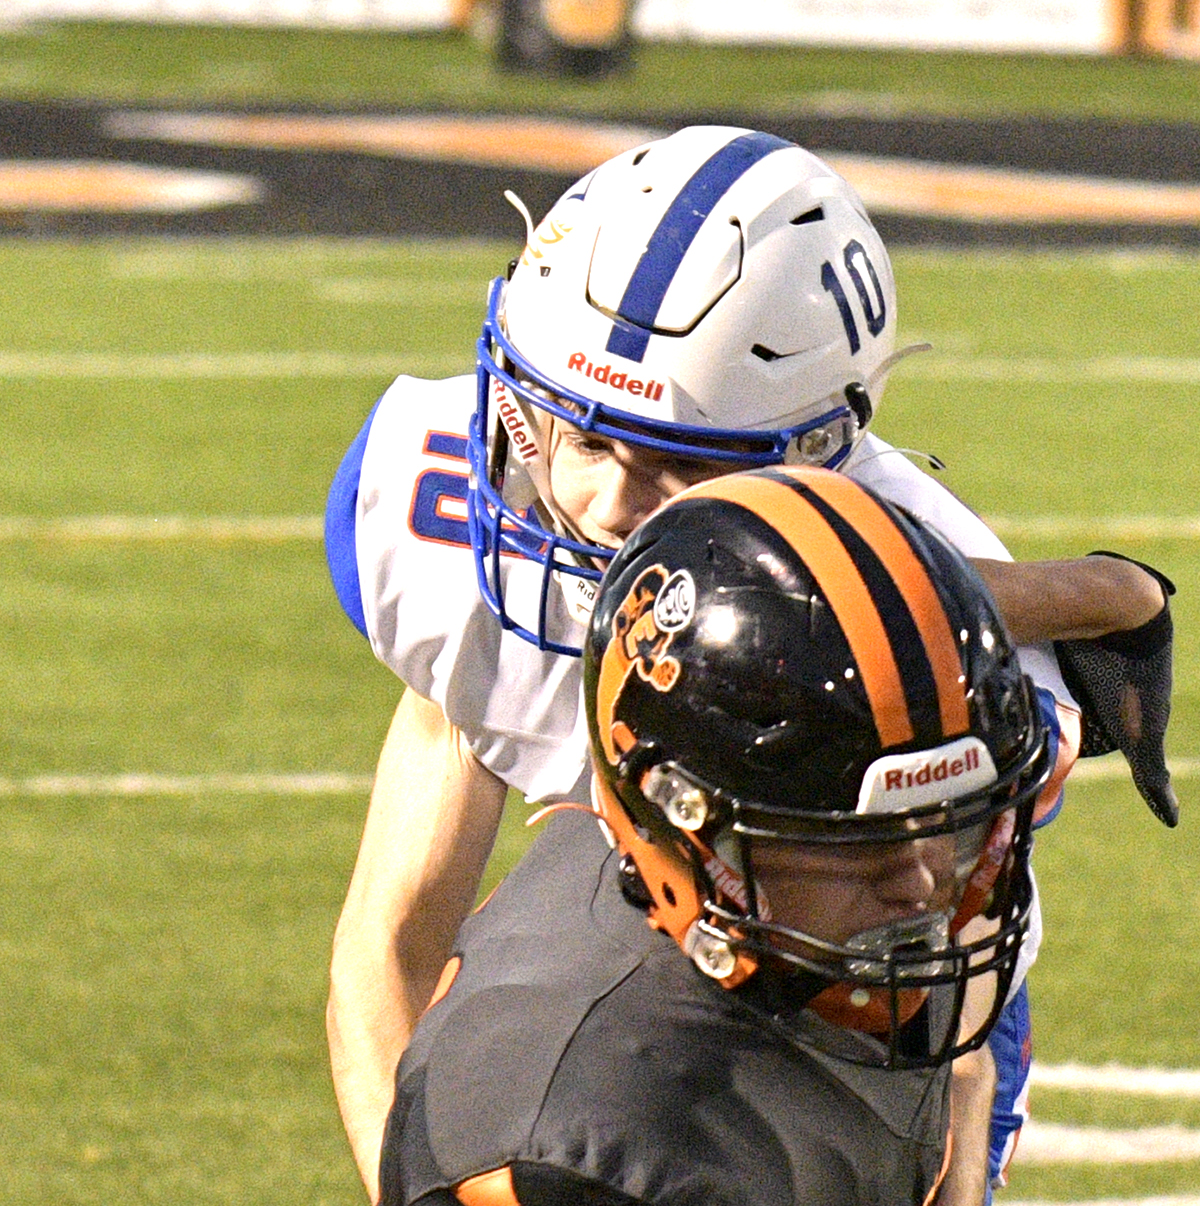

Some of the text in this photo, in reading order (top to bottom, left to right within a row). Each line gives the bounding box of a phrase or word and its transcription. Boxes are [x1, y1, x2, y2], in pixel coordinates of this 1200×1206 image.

[821, 238, 886, 356] 10
[567, 351, 665, 402] Riddell
[494, 379, 539, 460] Riddell
[884, 746, 979, 792] Riddell
